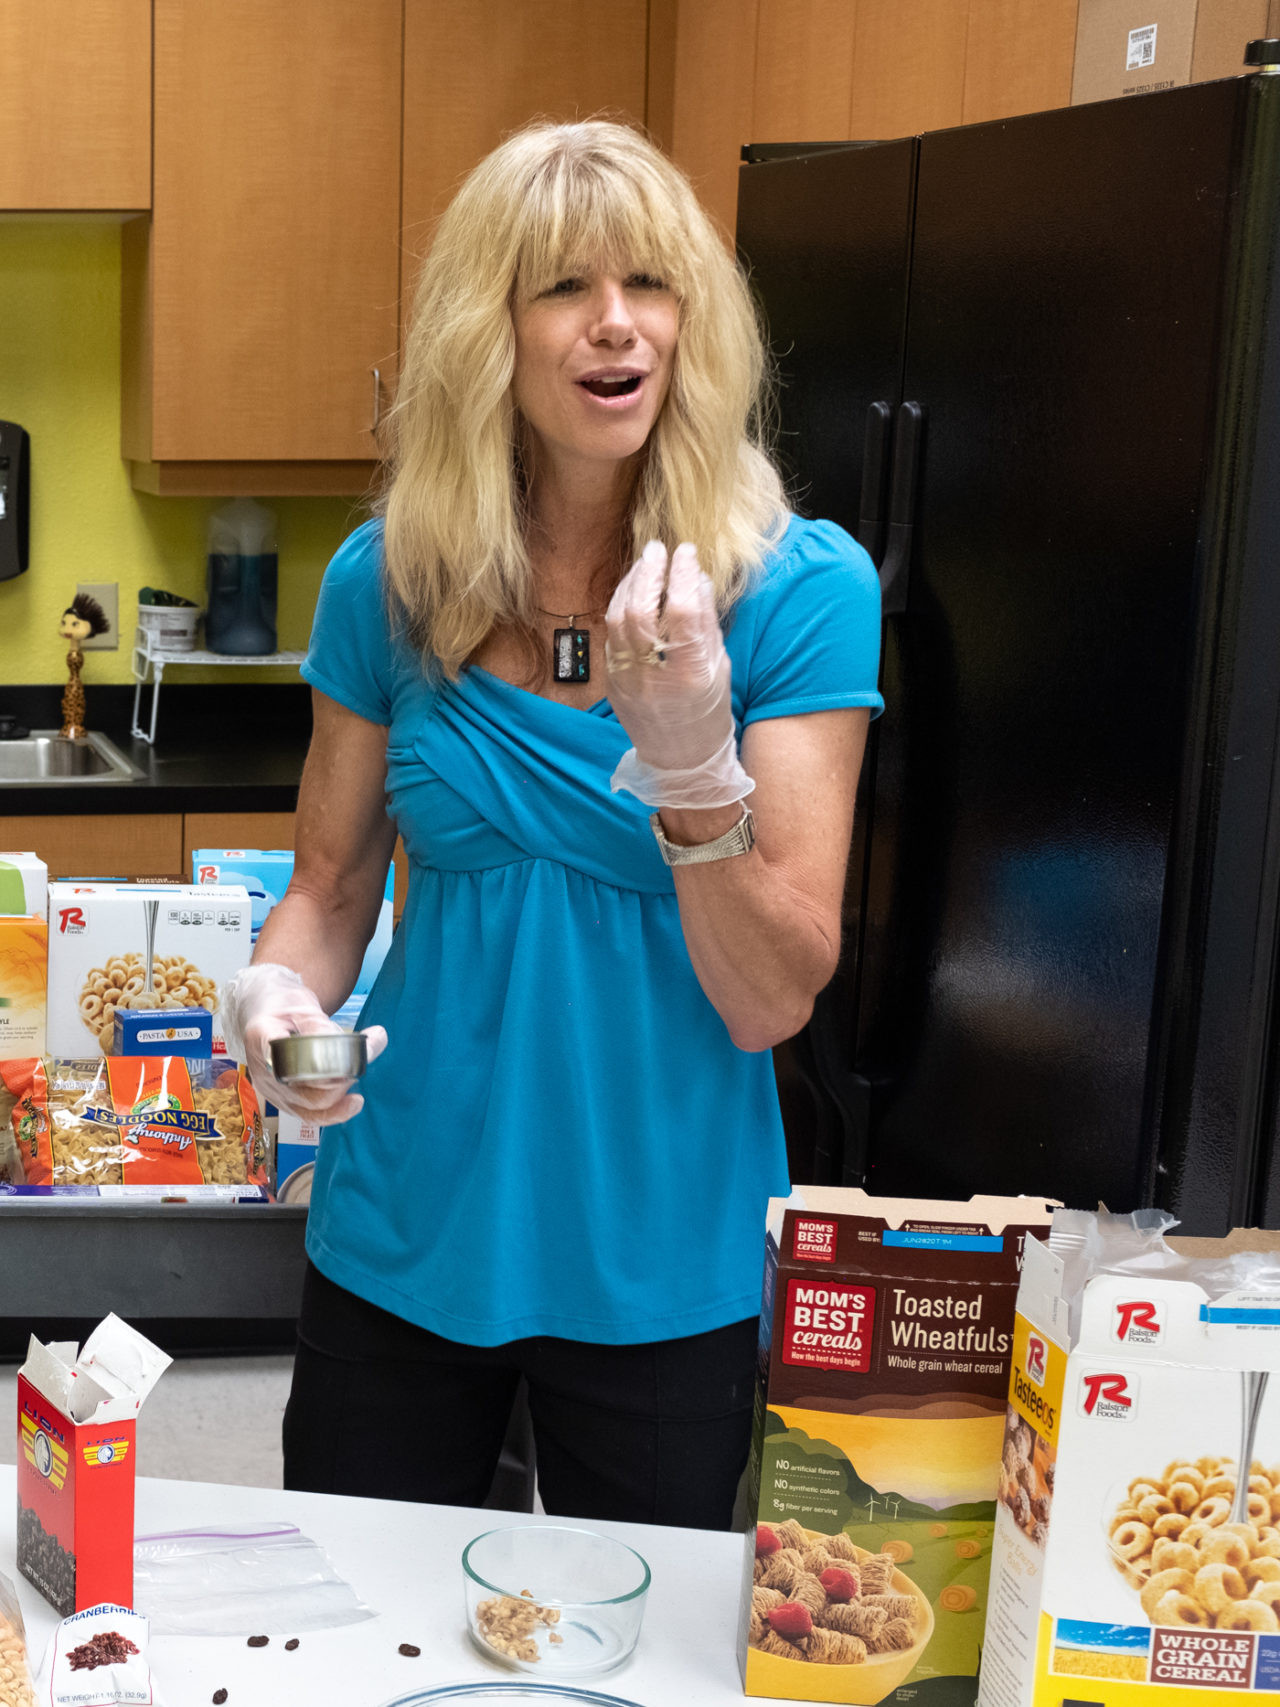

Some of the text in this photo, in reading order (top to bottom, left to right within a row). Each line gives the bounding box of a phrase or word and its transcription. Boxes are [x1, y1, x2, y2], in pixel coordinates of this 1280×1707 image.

[100, 1111, 206, 1130] EGG NOODLES
[798, 1222, 834, 1232] MOM'S
[797, 1243, 832, 1252] cereals
[798, 1232, 832, 1244] BEST
[796, 1288, 866, 1310] MOM'S
[893, 1288, 982, 1320] Toasted
[794, 1306, 864, 1332] BEST
[1116, 1301, 1160, 1341] R
[792, 1331, 862, 1350] cereals
[1128, 1328, 1158, 1338] Ralston
[1128, 1335, 1152, 1344] Foods
[792, 1352, 860, 1367] How the best days begin
[888, 1355, 1002, 1374] Whole grain wheat cereal
[1028, 1338, 1044, 1375] R
[1014, 1366, 1054, 1429] Tasteeos
[1084, 1373, 1132, 1416] R
[1096, 1409, 1122, 1418] Foods
[1098, 1401, 1129, 1412] Ralston
[24, 1401, 64, 1444] LION
[776, 1459, 840, 1476] NO artificial flavors
[774, 1479, 788, 1489] NO
[789, 1485, 818, 1494] synthetic
[773, 1498, 784, 1511] 8g
[786, 1502, 800, 1510] fiber
[814, 1507, 838, 1516] serving
[1160, 1634, 1250, 1653] WHOLE
[1156, 1650, 1250, 1670] GRAIN
[1155, 1665, 1246, 1683] CEREAL
